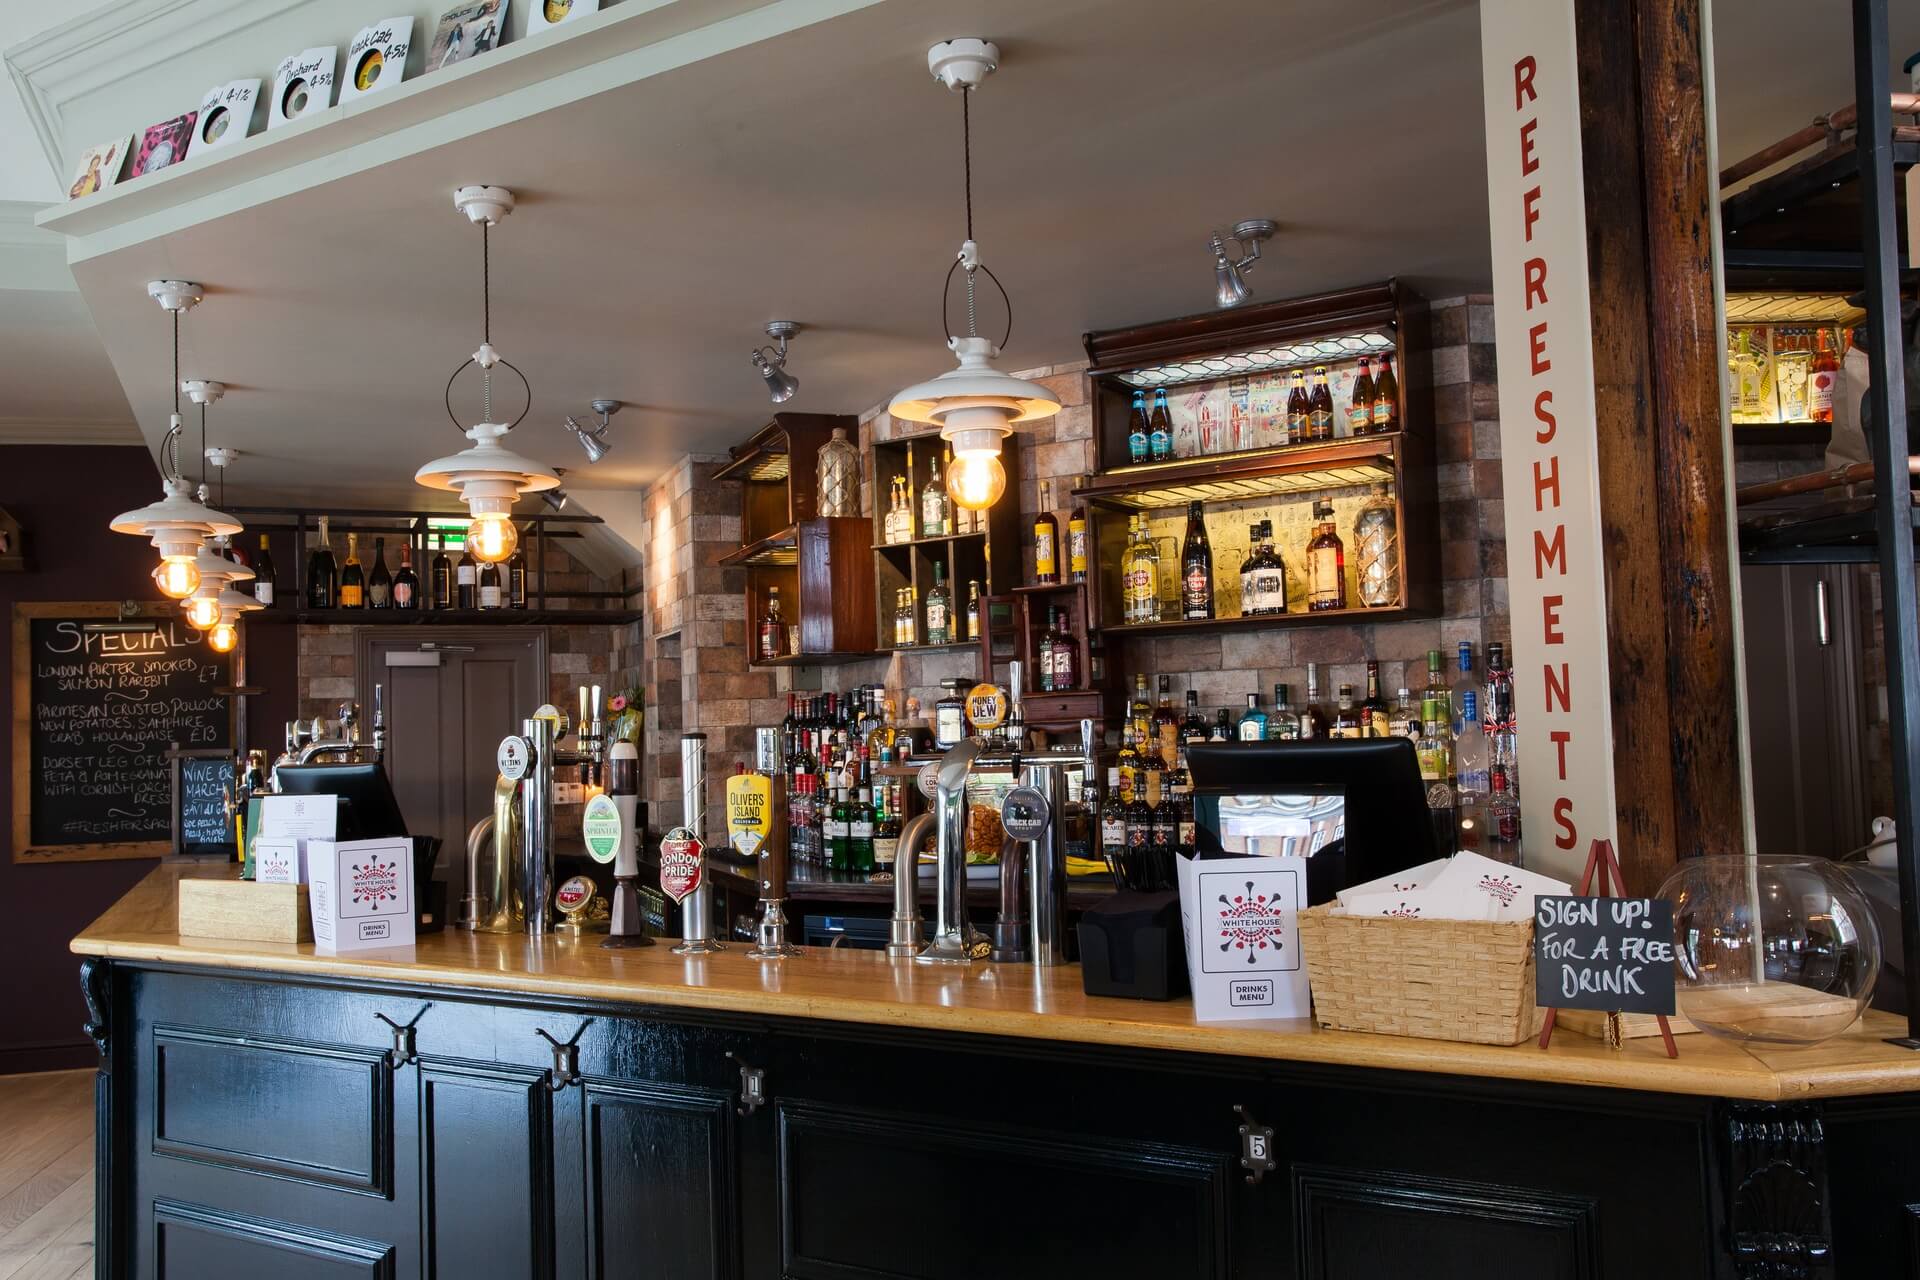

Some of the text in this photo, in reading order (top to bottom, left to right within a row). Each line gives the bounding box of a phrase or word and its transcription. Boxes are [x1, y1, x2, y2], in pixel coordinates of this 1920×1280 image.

[286, 57, 323, 83] Orchard
[1514, 54, 1577, 851] REFRESHMENTS
[46, 621, 203, 654] SPECIALS
[38, 658, 219, 683] LONDON PORTER SMOKED £7
[58, 674, 171, 690] SALMON RAREBIT
[38, 697, 225, 719] PARMESAN CRUSTED POLLOCK
[972, 696, 997, 705] HONEY
[972, 704, 997, 717] DEW
[40, 719, 65, 731] NEW
[138, 716, 205, 730] SAMPHIRE
[50, 725, 217, 745] CRAB HOLLANDAISE £13
[43, 756, 98, 769] DORSET
[98, 755, 129, 767] LEG
[134, 755, 156, 766] OF
[43, 771, 75, 782] FETA
[94, 769, 172, 782] POMEGRANAT
[183, 763, 214, 781] WINE
[44, 783, 171, 796] WITH CORNISH ORCH
[186, 783, 225, 797] MARCH
[134, 794, 171, 804] DRESS
[730, 792, 764, 806] OLIVER'S
[734, 806, 760, 817] ISLAND
[63, 818, 170, 834] #FRESHFORSPRI
[660, 852, 702, 867] LONDON
[665, 866, 695, 877] PRIDE
[1538, 898, 1652, 929] SIGN UP!
[1222, 918, 1281, 927] WHITE HOUSE
[1541, 932, 1675, 964] FOR A FREE
[1235, 985, 1268, 993] DRINKS
[1562, 964, 1645, 999] DRINK
[1239, 993, 1265, 1001] MENU
[1254, 1137, 1265, 1156] 5
